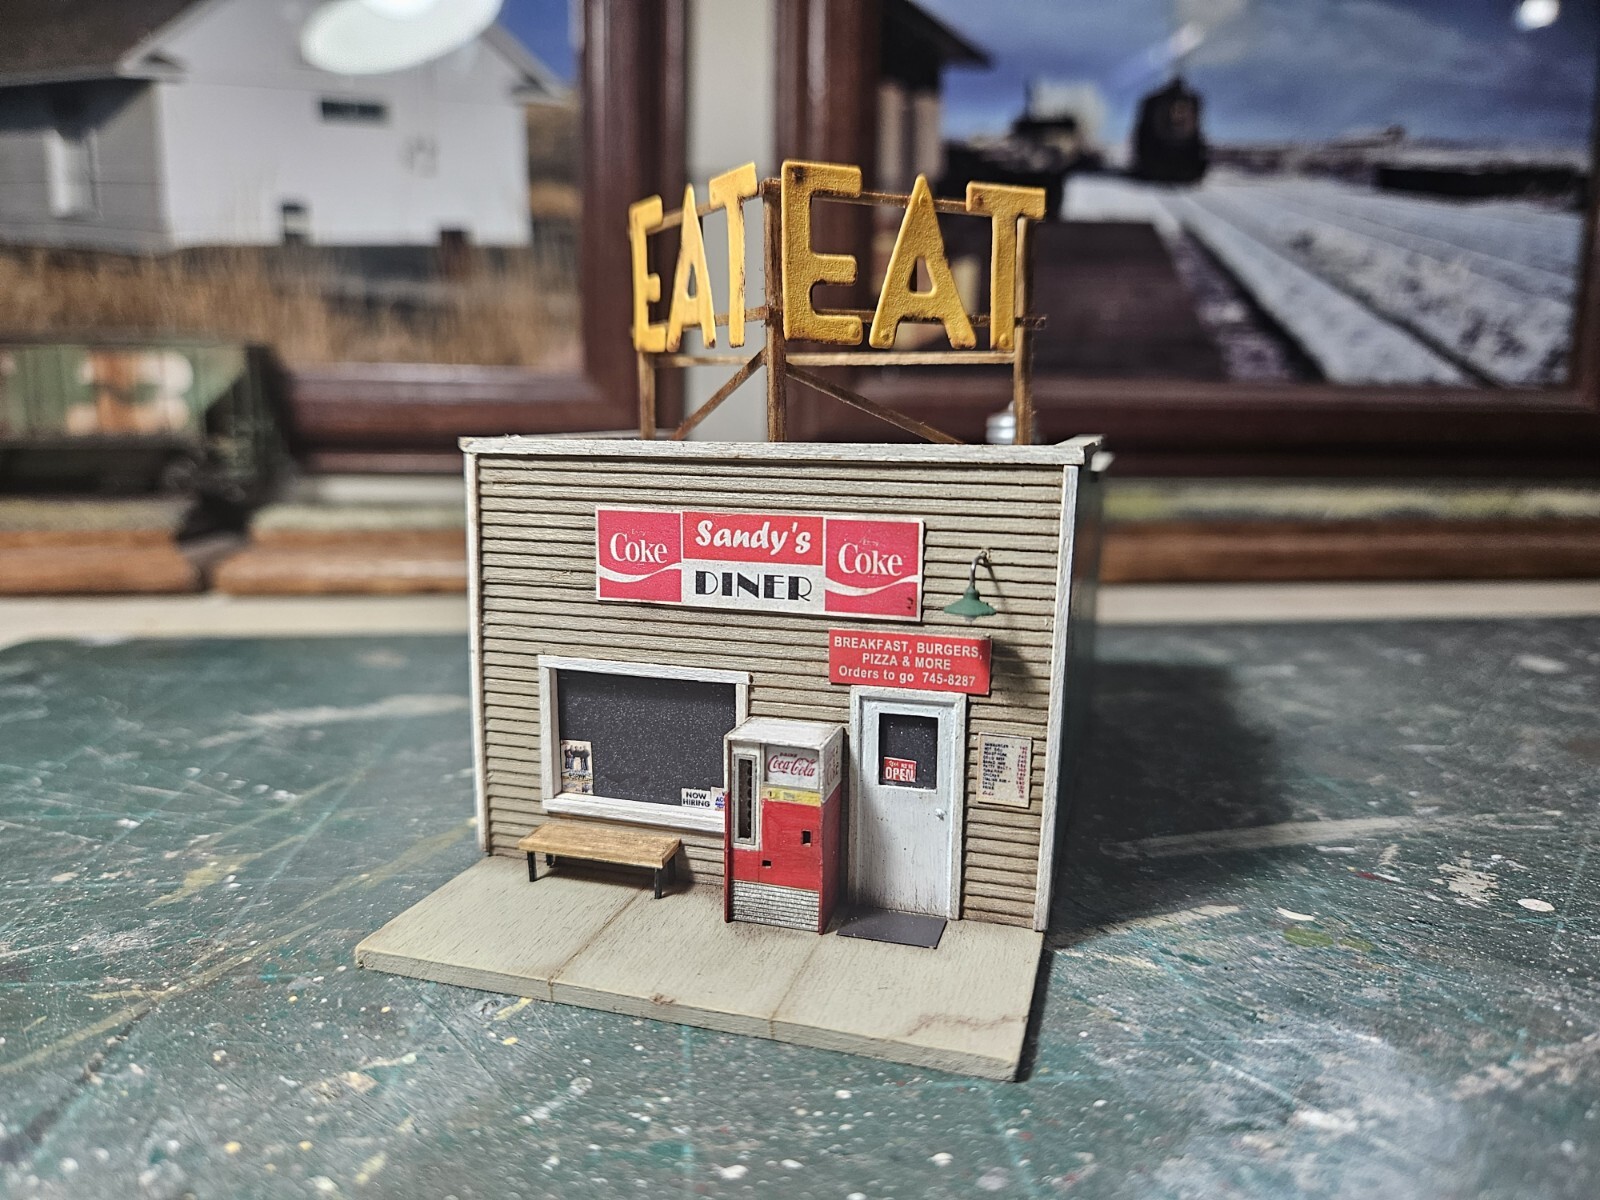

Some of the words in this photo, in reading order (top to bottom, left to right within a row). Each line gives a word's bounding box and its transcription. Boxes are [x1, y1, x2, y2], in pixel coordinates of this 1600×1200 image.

[628, 162, 758, 353] EAT
[781, 159, 1047, 350] EAT
[610, 532, 668, 564] Coke
[695, 519, 812, 555] Sandy's
[838, 542, 903, 577] Coke
[695, 570, 813, 602] DINER
[834, 636, 912, 654] BREAKFAST,
[916, 642, 983, 660] BURGERS,
[862, 653, 898, 666] PIZZA
[902, 656, 910, 667] &
[915, 657, 951, 671] MORE
[838, 665, 879, 679] Orders
[883, 669, 895, 680] to
[899, 673, 914, 684] go
[922, 671, 976, 687] 745-8287
[767, 754, 817, 777] Coca-Cola
[885, 766, 915, 782] OPEN
[682, 798, 711, 808] HIRING
[685, 791, 707, 800] NOW
